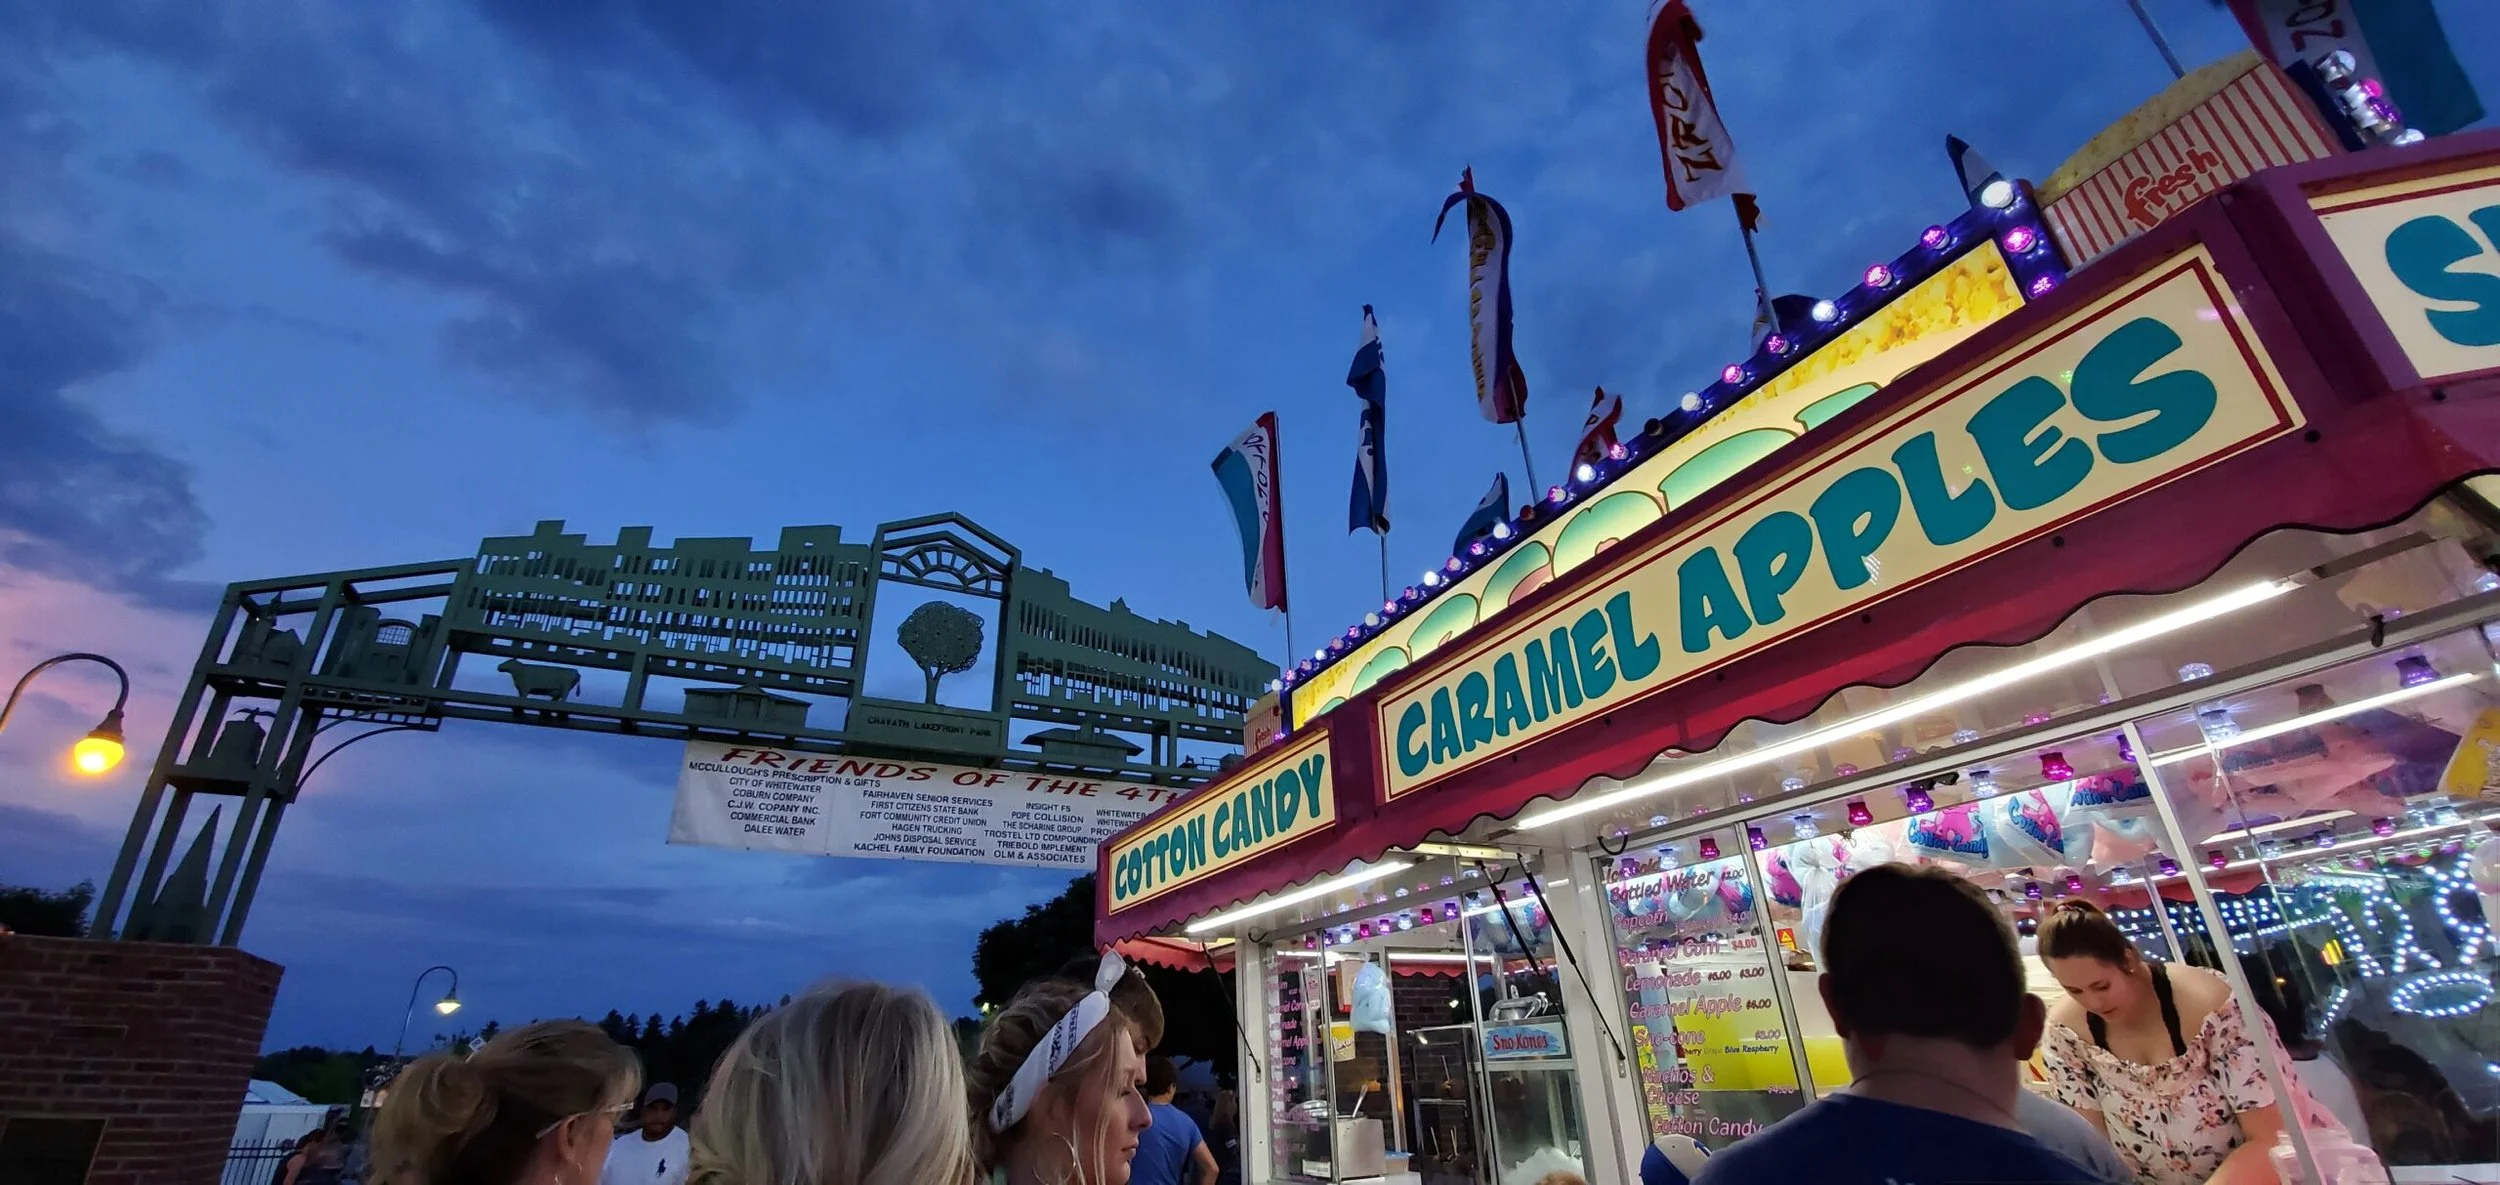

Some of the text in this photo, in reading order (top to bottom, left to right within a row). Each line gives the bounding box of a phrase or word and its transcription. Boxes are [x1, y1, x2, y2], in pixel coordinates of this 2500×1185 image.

[2124, 148, 2219, 228] fresh
[1396, 316, 2218, 778] CARAMEL APPLES
[688, 761, 881, 788] MCCULLOUGH'S PRESCRIPTION & GIFTS
[721, 748, 938, 781] FRIENDS
[952, 771, 1011, 788] OF
[1026, 776, 1102, 797] THE
[729, 776, 822, 794] CITY OF WHITEWATER
[733, 788, 815, 804] COBURN COMPANY
[862, 789, 993, 807] FAIRHAVEN SENIOR SERVICES
[758, 802, 800, 814] COPANY
[802, 805, 821, 815] INC.
[870, 800, 979, 816] FIRST CITIZENS STATE BANK
[1025, 802, 1071, 813] INSIGHT FS
[730, 811, 816, 826] COMMERCIAL BANK
[859, 810, 987, 827] FORT COMMUNITY CREDIT UNION
[1002, 820, 1082, 833] THE SCHARINE GROUP
[1011, 811, 1084, 824] POPE COLLISION
[1115, 753, 1325, 900] COTTON CANDY
[2008, 796, 2047, 843] Cotton
[744, 823, 806, 836] DALEE WATER
[891, 823, 963, 835] HAGEN TRUCKING
[984, 829, 1102, 845] TROSTEL LTD COMPOUNDING
[1907, 816, 1989, 859] Cotton Candy
[873, 832, 977, 847] JOHNS DISPOSAL SERVICE
[997, 840, 1087, 853] TRIEBOLD IMPLEMENT
[853, 843, 986, 857] KACHEL FAMILY FOUNDATION
[993, 849, 1086, 864] OLM & ASSOCIATES
[1610, 867, 1744, 901] Bottled Water $2.00
[1613, 911, 1668, 933] Popcorn
[1618, 938, 1757, 968] Caramel Corn $4.00
[1625, 968, 1701, 991] Lemonade
[1630, 997, 1690, 1019] Caramel
[1694, 993, 1742, 1020] Apple
[1635, 1028, 1705, 1046] Sno-cone
[1682, 1047, 1702, 1057] herry
[1724, 1045, 1740, 1054] Blue
[1742, 1044, 1779, 1054] Raspberry
[1642, 1064, 1714, 1083] Nachos &
[1646, 1085, 1700, 1105] Cheese
[1652, 1114, 1764, 1137] Cotton Candy
